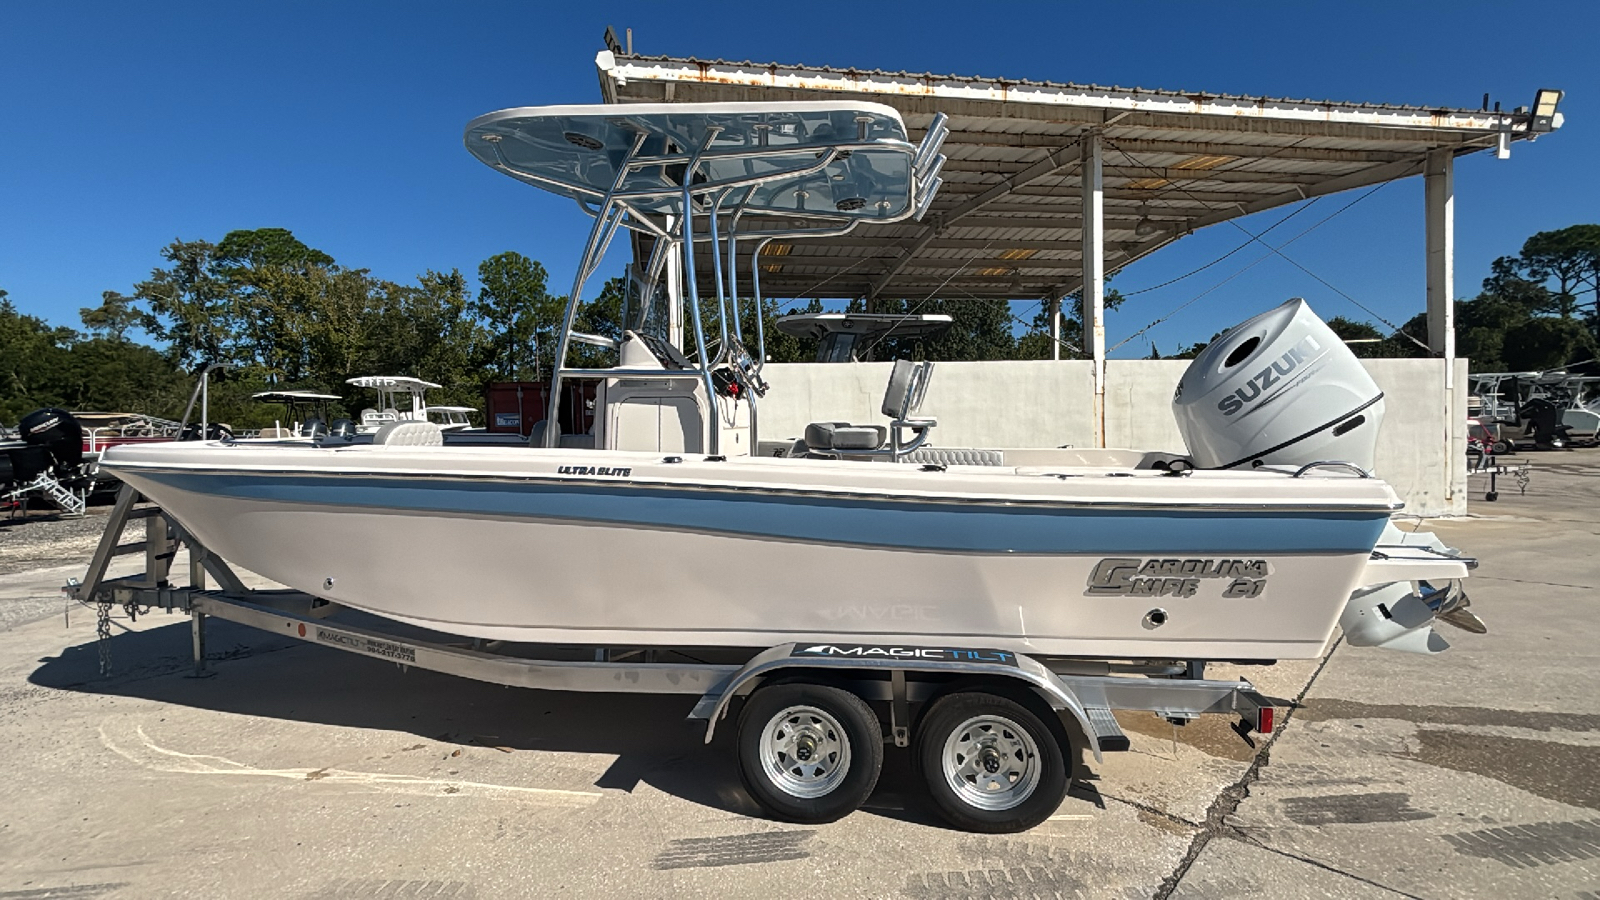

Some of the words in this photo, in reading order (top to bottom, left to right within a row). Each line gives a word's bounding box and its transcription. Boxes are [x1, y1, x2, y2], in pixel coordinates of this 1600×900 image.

[1217, 335, 1321, 416] SUZUKI
[557, 466, 596, 475] ULTRA
[597, 467, 632, 477] ELITE
[1222, 578, 1267, 599] 21
